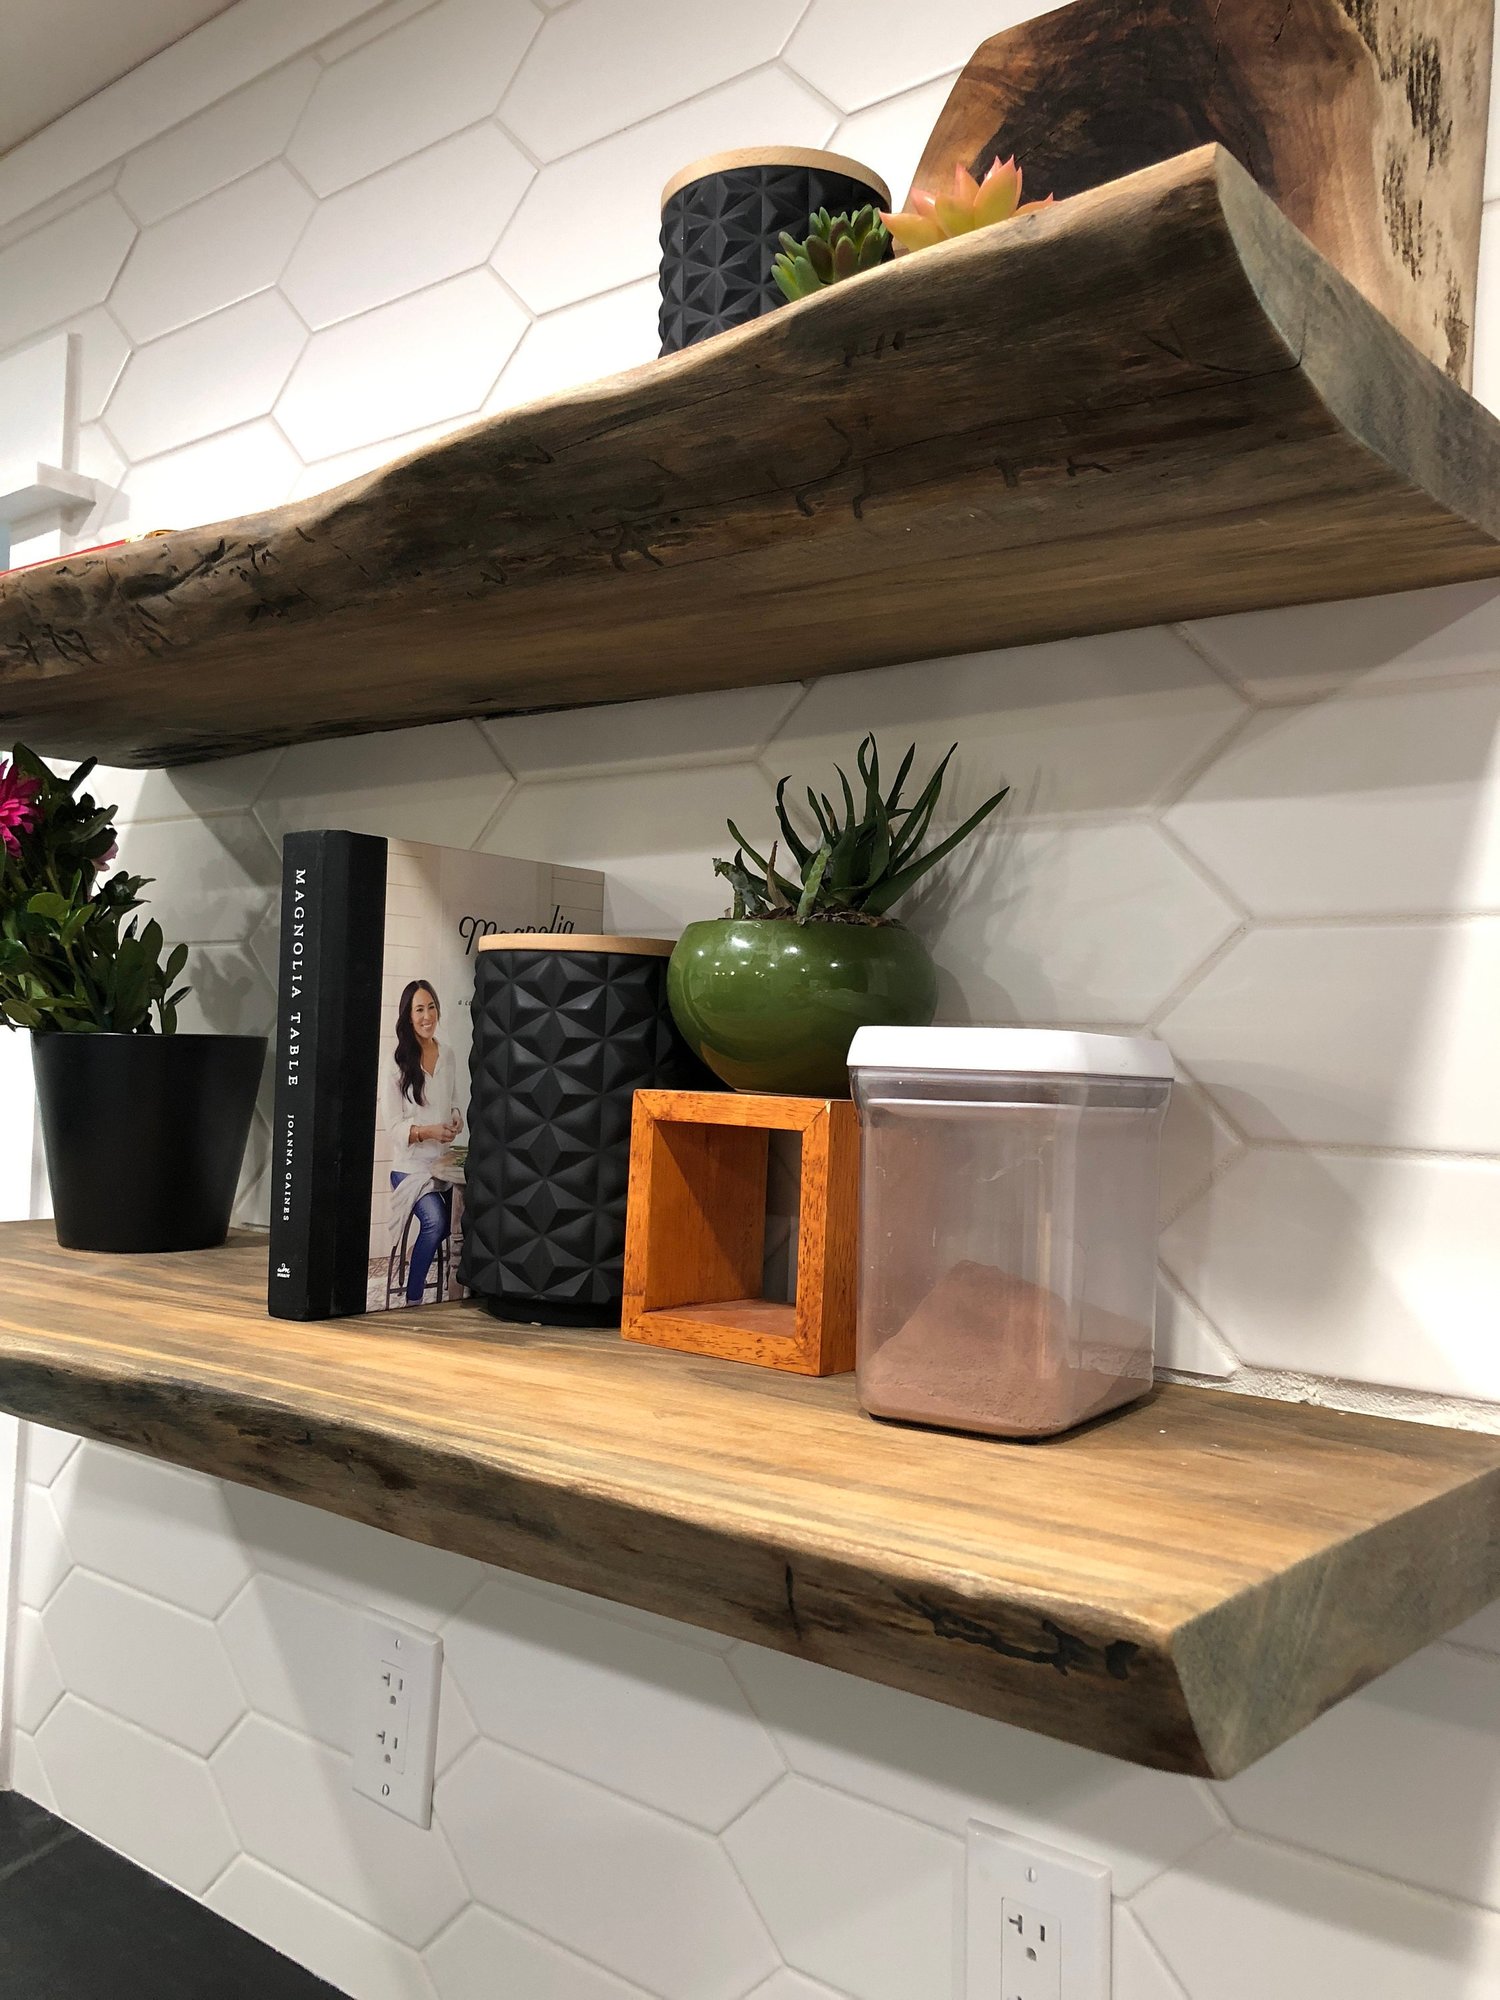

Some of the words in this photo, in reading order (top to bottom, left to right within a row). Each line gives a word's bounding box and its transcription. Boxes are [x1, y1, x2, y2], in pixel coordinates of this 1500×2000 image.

[291, 868, 306, 999] MAGNOLIA
[288, 1011, 301, 1086] TABLE
[286, 1114, 295, 1166] JOANNA
[283, 1172, 292, 1221] GAINES
